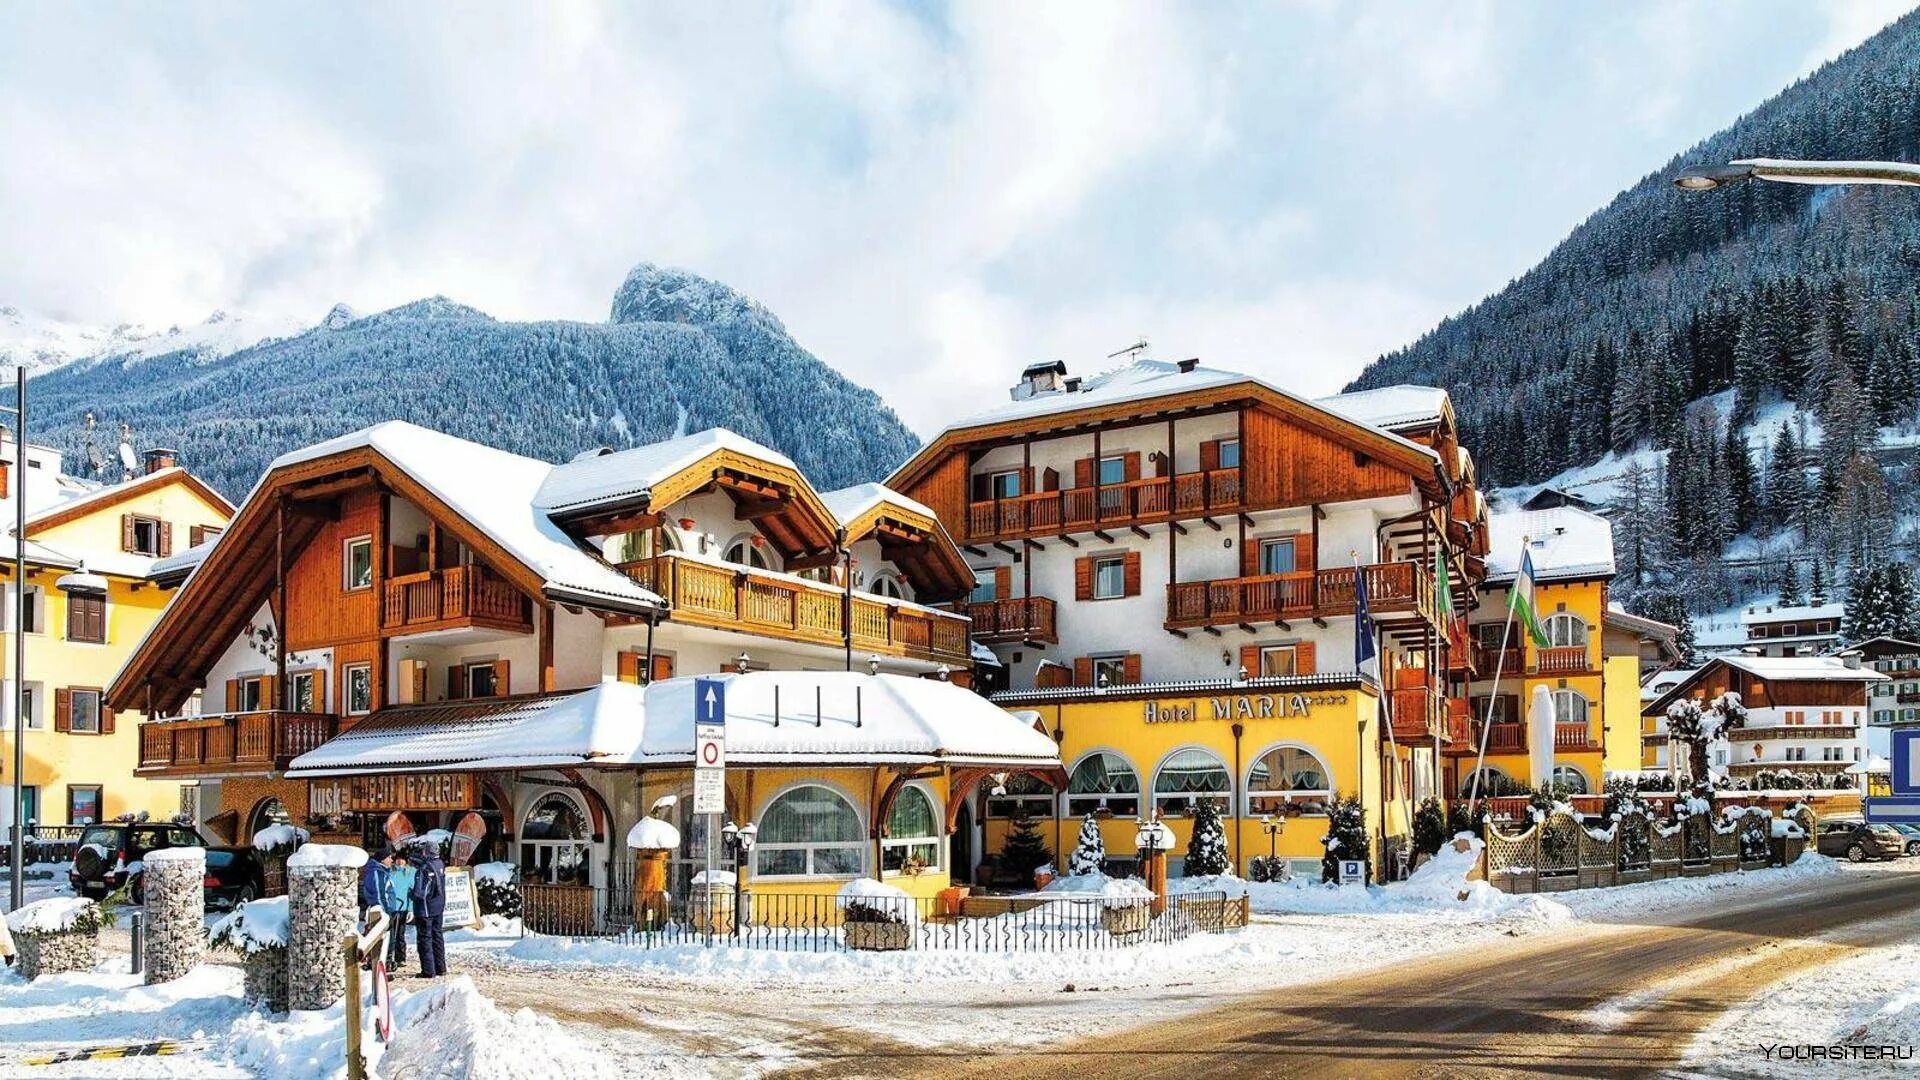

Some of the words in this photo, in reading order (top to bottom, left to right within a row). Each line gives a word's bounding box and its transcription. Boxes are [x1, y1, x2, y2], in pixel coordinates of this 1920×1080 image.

[1144, 701, 1196, 723] Hotel
[1211, 694, 1310, 720] MARIA
[1348, 865, 1356, 873] P
